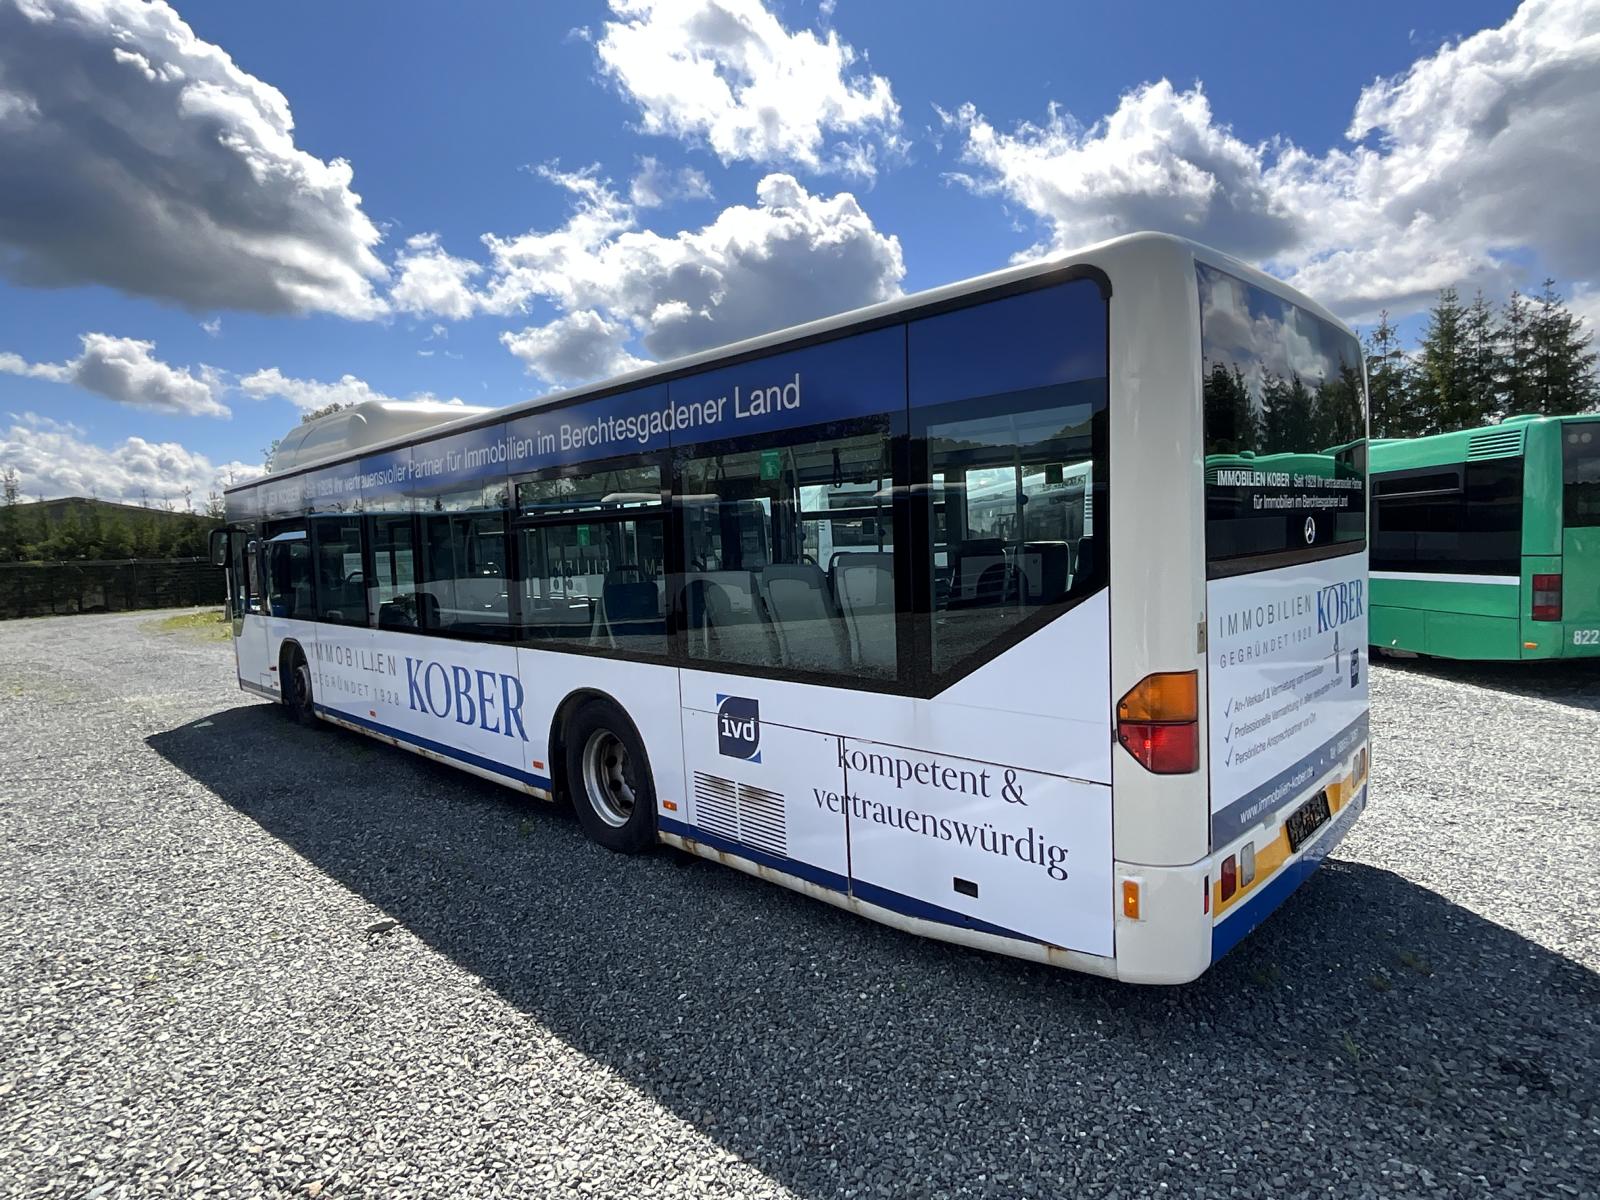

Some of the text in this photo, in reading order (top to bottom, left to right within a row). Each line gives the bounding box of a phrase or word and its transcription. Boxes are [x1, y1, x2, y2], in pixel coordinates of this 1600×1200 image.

[344, 462, 406, 492] vertrauensvoller
[408, 456, 444, 480] Partner
[446, 450, 461, 473] für
[464, 436, 534, 468] Immobilien
[537, 431, 555, 454] im
[560, 397, 727, 451] Berchtesgadener
[735, 372, 800, 419] Land
[1217, 470, 1266, 487] IMMOBILIEN
[1266, 471, 1290, 487] KOBER
[1253, 494, 1263, 510] für
[1219, 578, 1364, 638] IMMOBILIEN KOBER
[1219, 634, 1290, 669] GEGRÜNDET
[1573, 629, 1600, 646] 822
[310, 642, 530, 742] IMMOBILIEN KOBER
[373, 687, 400, 706] 1928
[721, 712, 757, 743] ivd
[837, 745, 1029, 807] kompetent &
[812, 787, 1069, 882] vertrauenswürdig
